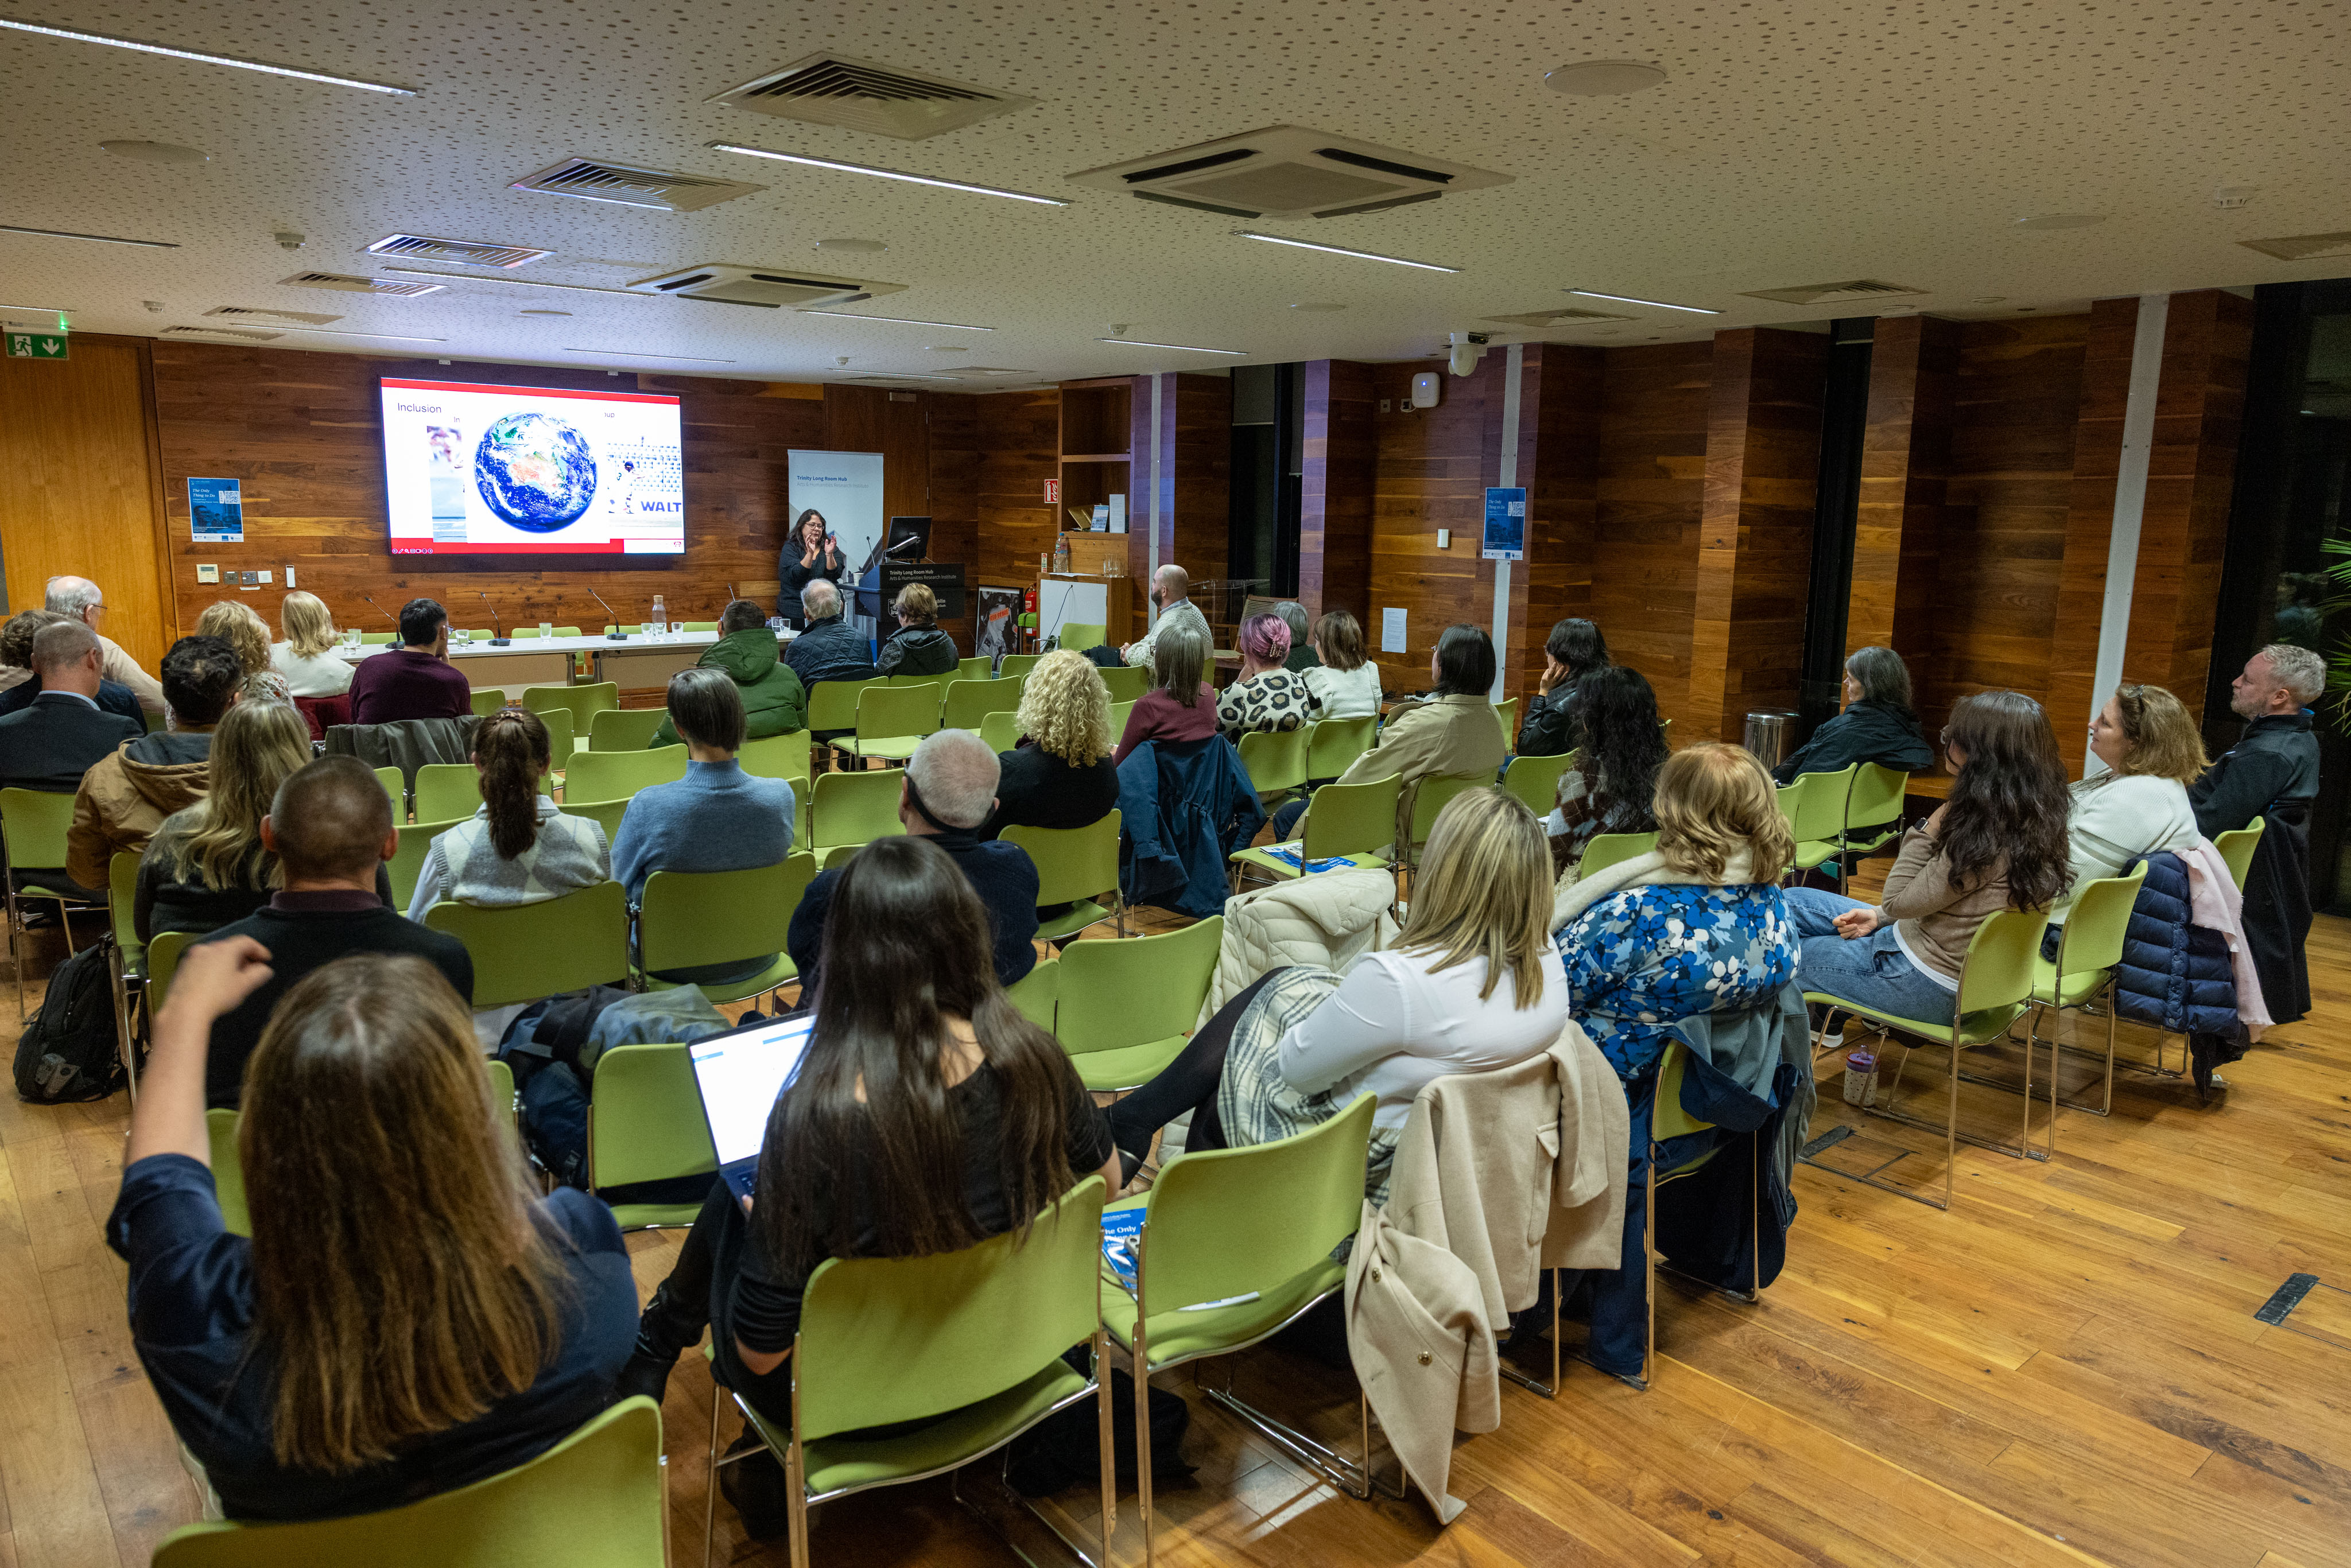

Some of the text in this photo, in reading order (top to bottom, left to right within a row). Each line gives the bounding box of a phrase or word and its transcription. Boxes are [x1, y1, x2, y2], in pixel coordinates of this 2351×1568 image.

[398, 402, 441, 413] Inclusion
[997, 609, 1008, 618] SCARE
[1116, 1225, 1136, 1233] Only
